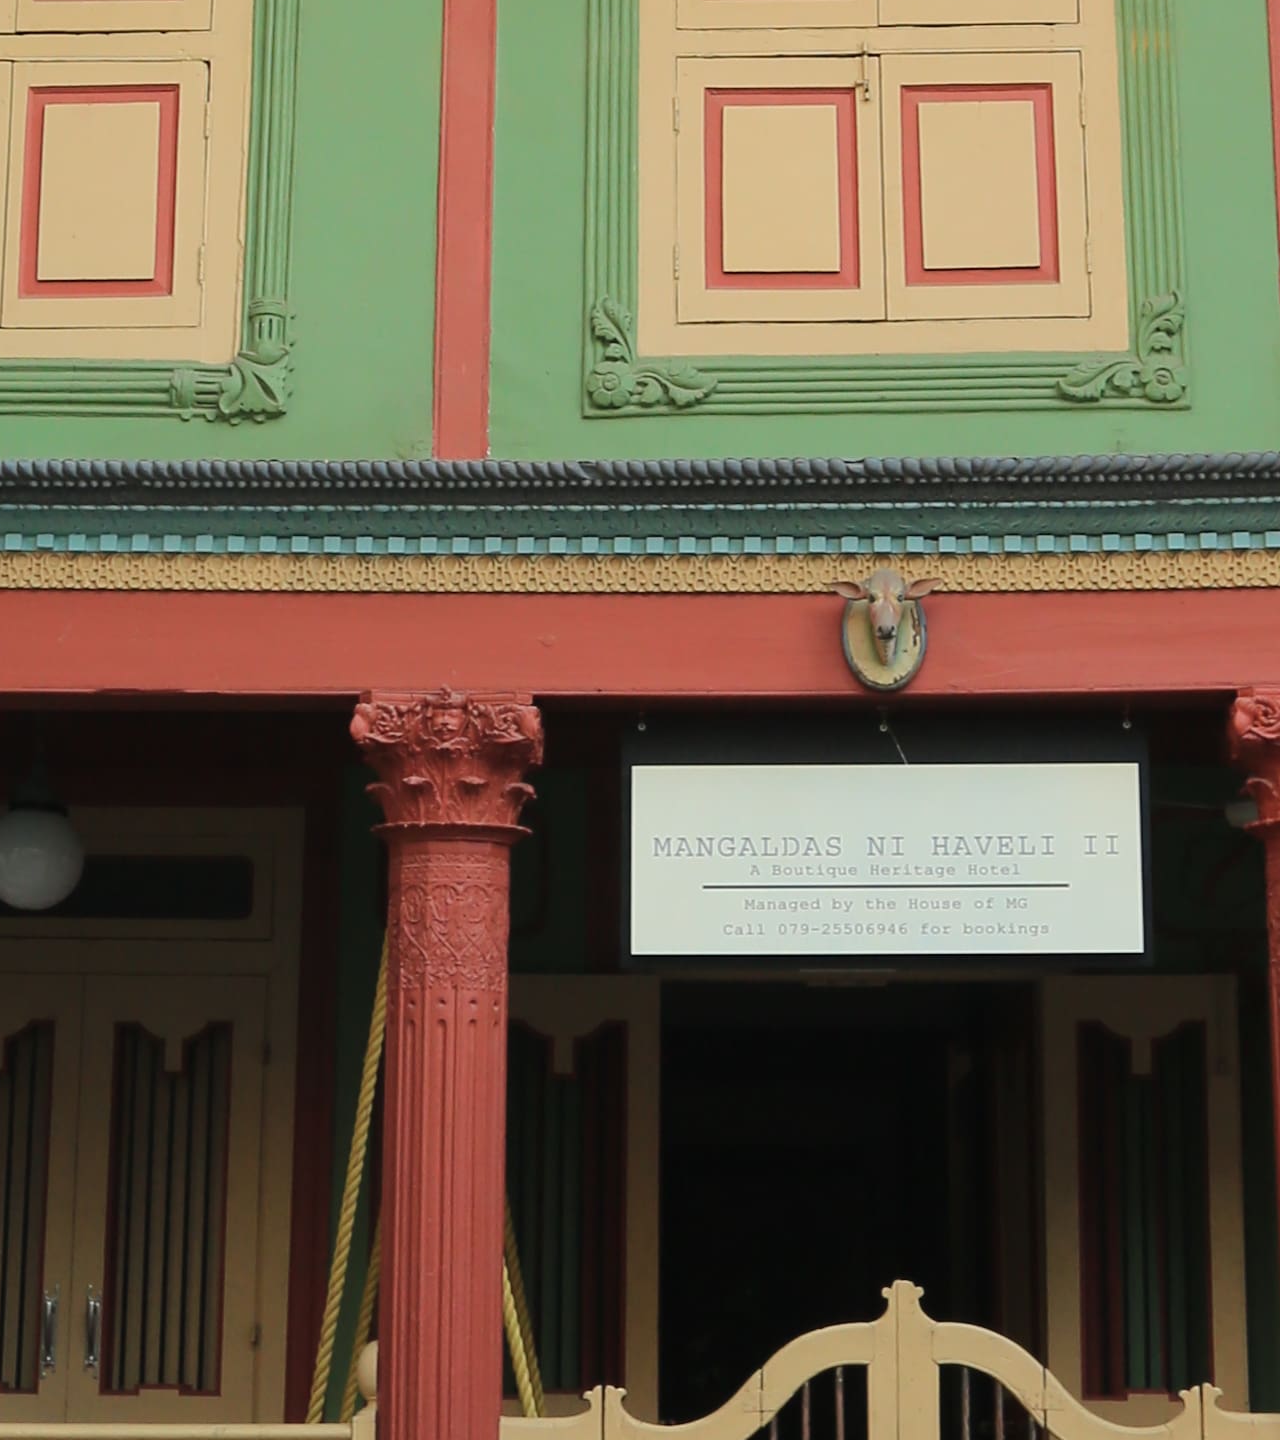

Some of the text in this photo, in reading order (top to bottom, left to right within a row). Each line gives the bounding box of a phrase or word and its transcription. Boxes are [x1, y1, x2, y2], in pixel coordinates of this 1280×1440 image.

[652, 834, 1119, 858] MANGALDAS NI HAVELI II
[749, 863, 1021, 879] A Boutique Heritage Hotel
[743, 897, 1028, 913] Managed by the House of MG
[722, 922, 1050, 937] Call 079-25506946 for bookings
